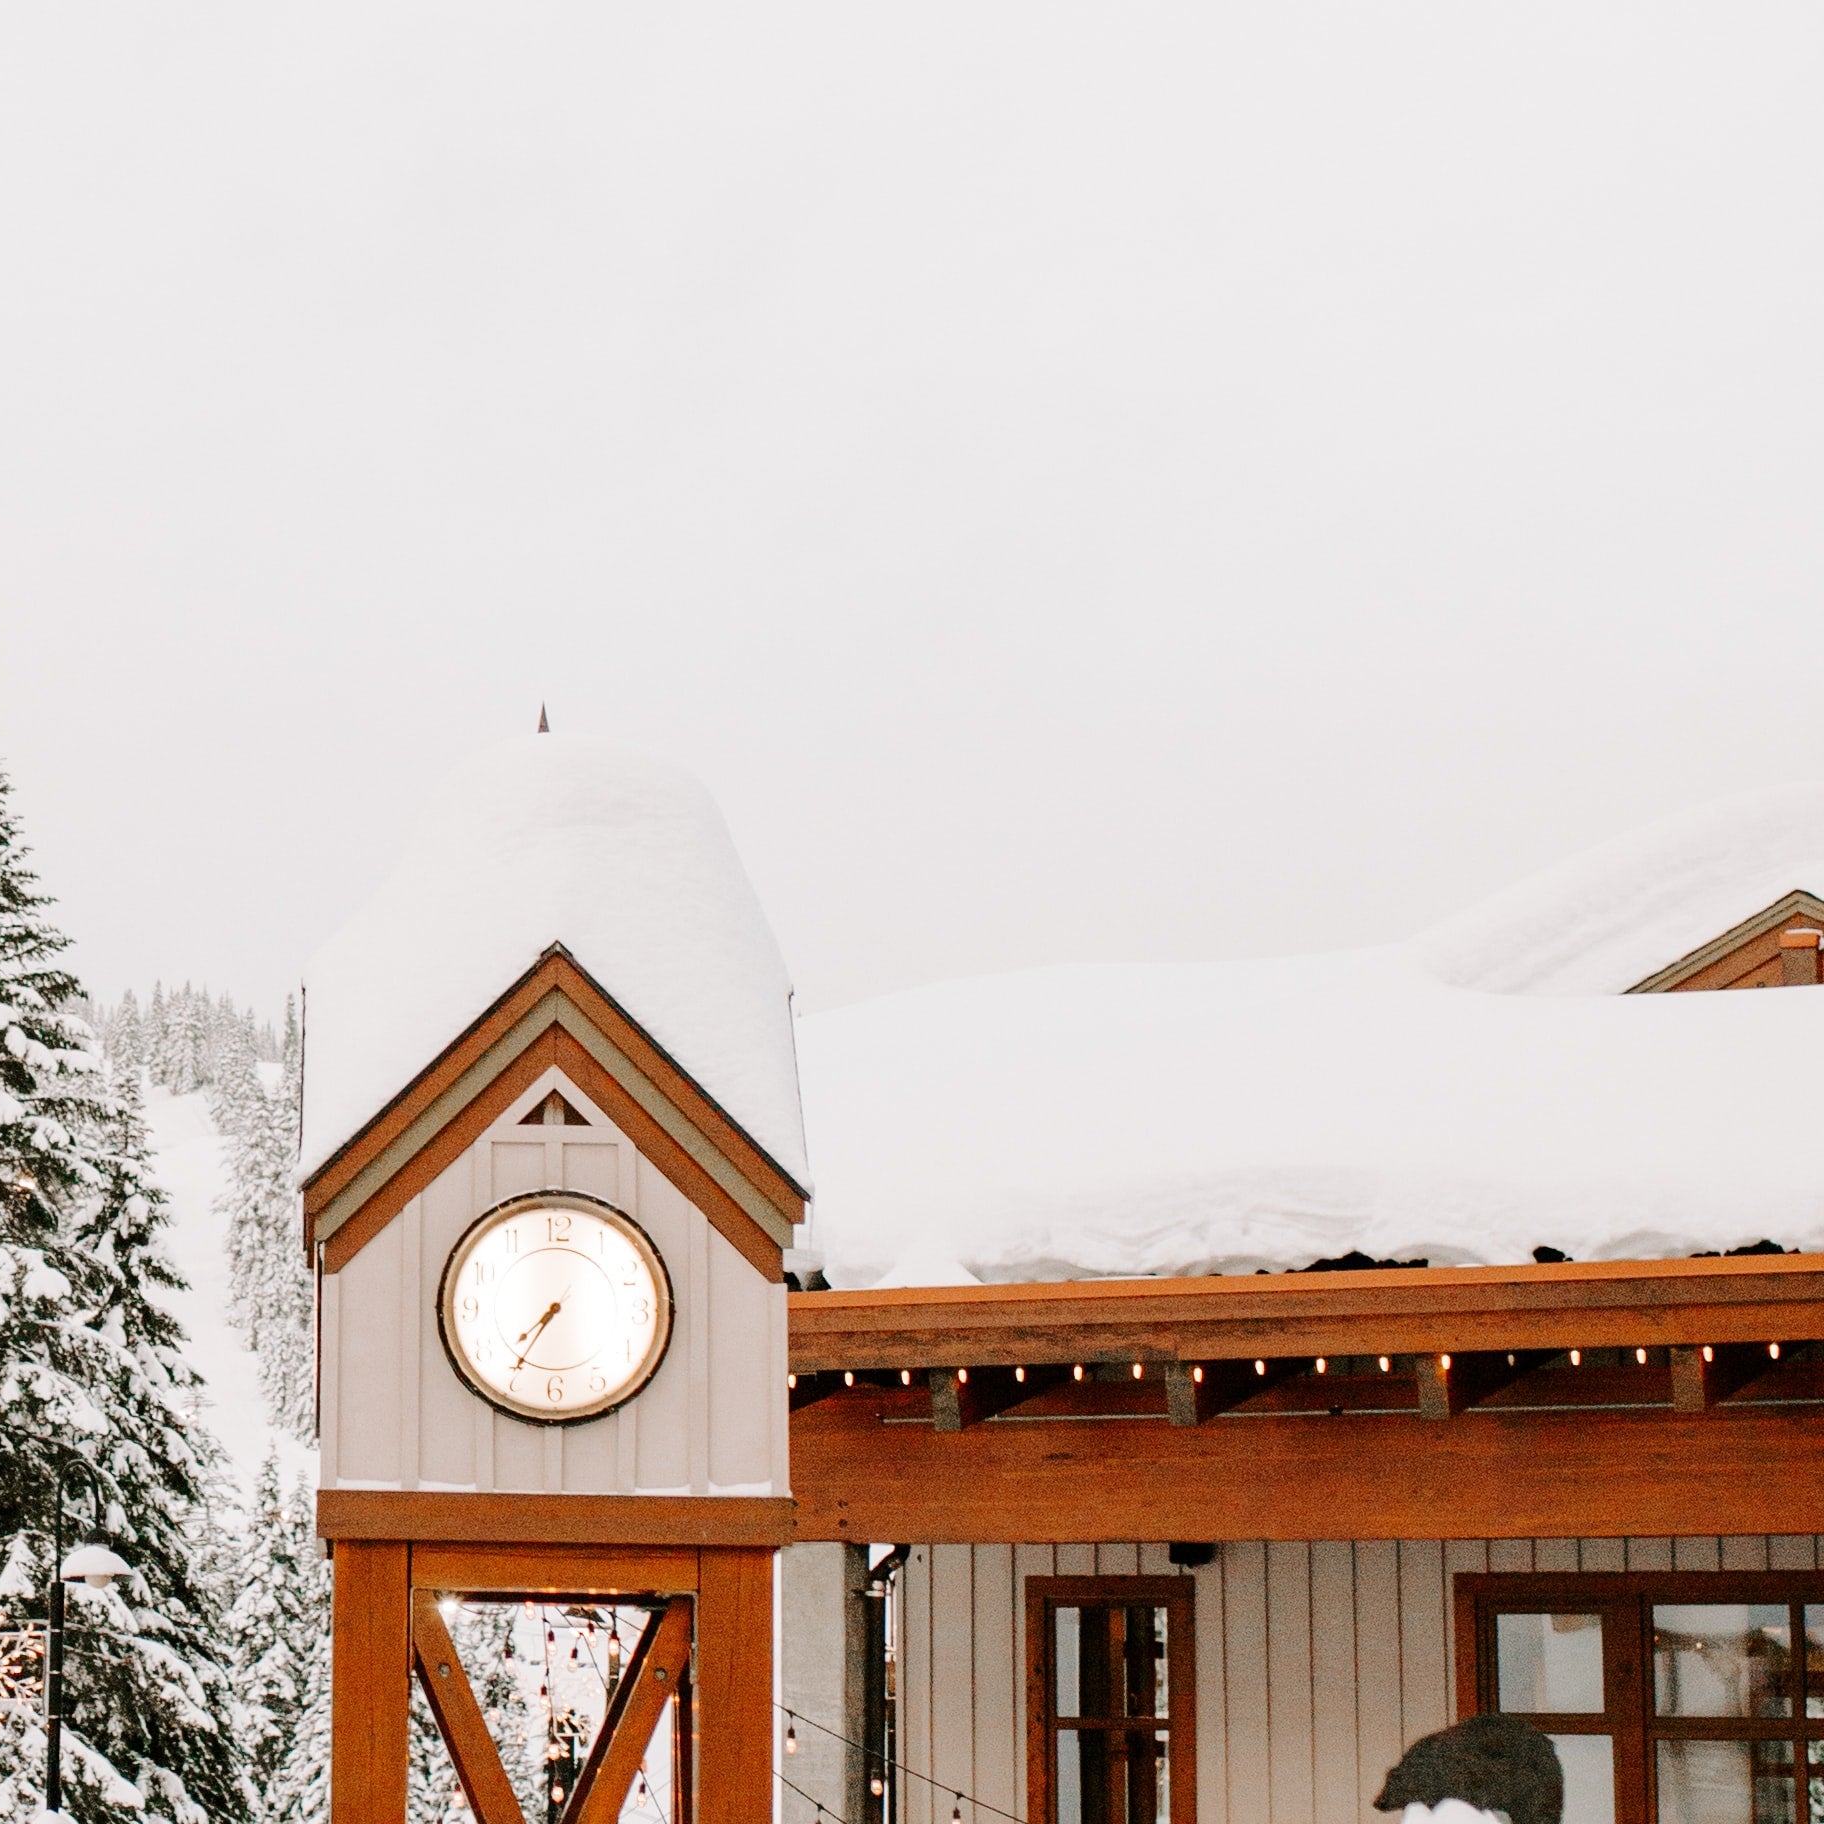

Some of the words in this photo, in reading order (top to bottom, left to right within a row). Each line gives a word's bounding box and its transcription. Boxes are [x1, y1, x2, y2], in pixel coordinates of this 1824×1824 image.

[504, 1229, 519, 1254] 11
[547, 1215, 572, 1242] 12
[598, 1229, 605, 1255] 1
[475, 1260, 496, 1286] 10
[620, 1259, 638, 1286] 2
[461, 1295, 480, 1323] 9
[630, 1297, 650, 1325] 3
[475, 1336, 493, 1363] 8
[546, 1374, 564, 1404] 6
[588, 1366, 607, 1393] 5
